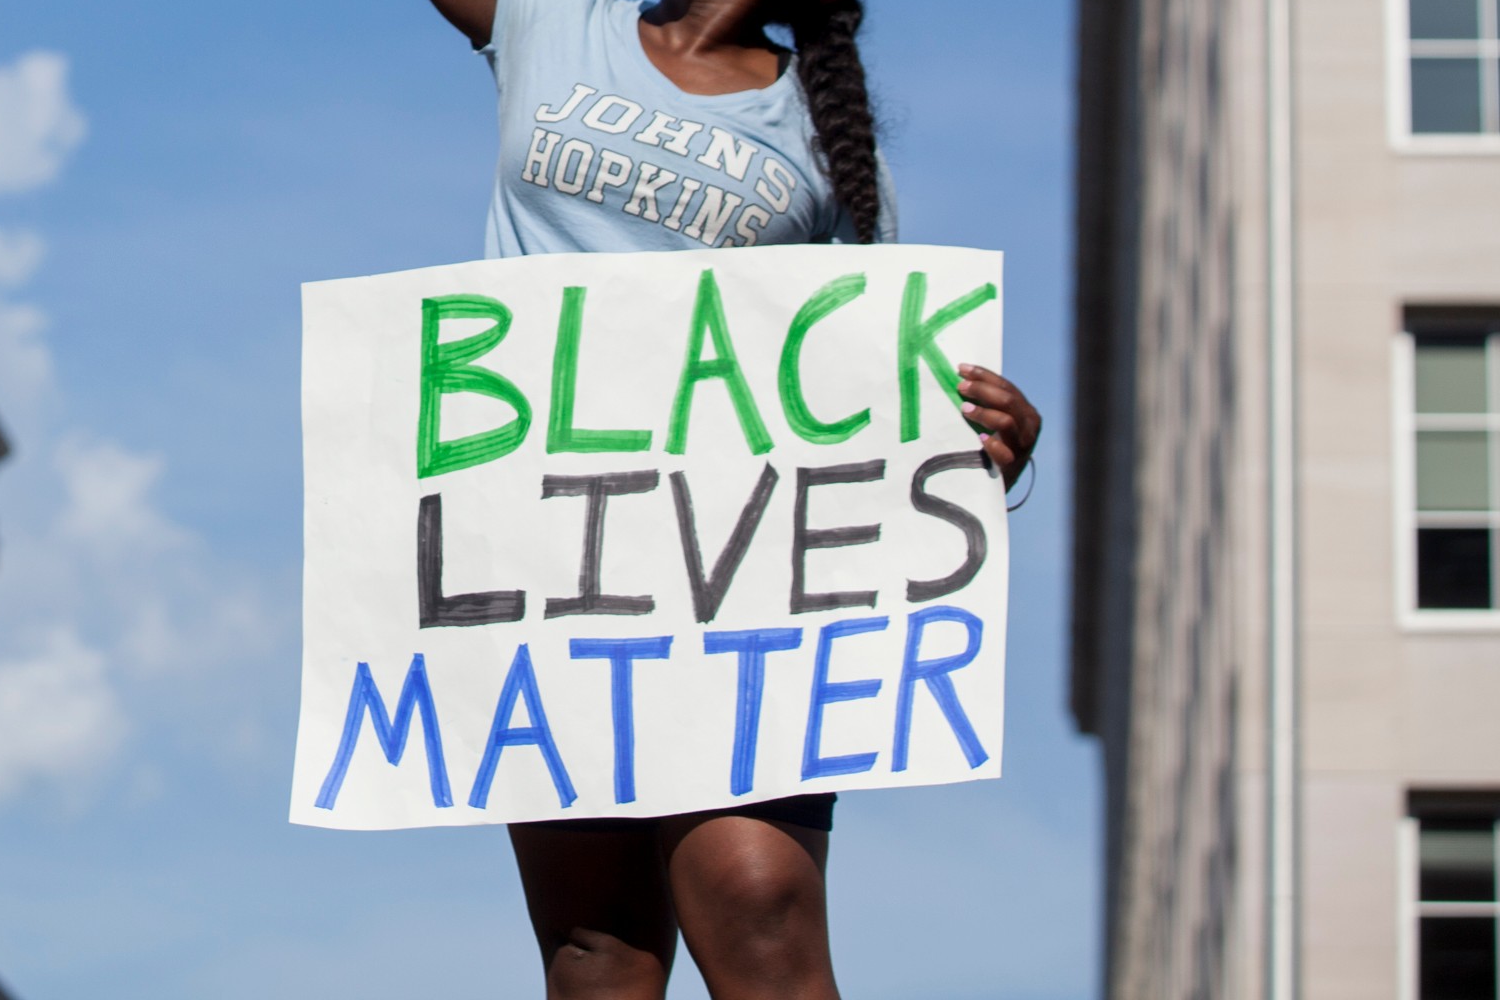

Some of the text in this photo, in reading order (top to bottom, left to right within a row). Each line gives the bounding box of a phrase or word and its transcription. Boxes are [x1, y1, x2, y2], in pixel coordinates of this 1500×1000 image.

[521, 126, 771, 248] HOPKINS
[534, 83, 797, 214] JOHNS
[417, 267, 998, 479] BLACK
[417, 448, 993, 629] LIVES
[314, 604, 990, 810] MATTER
